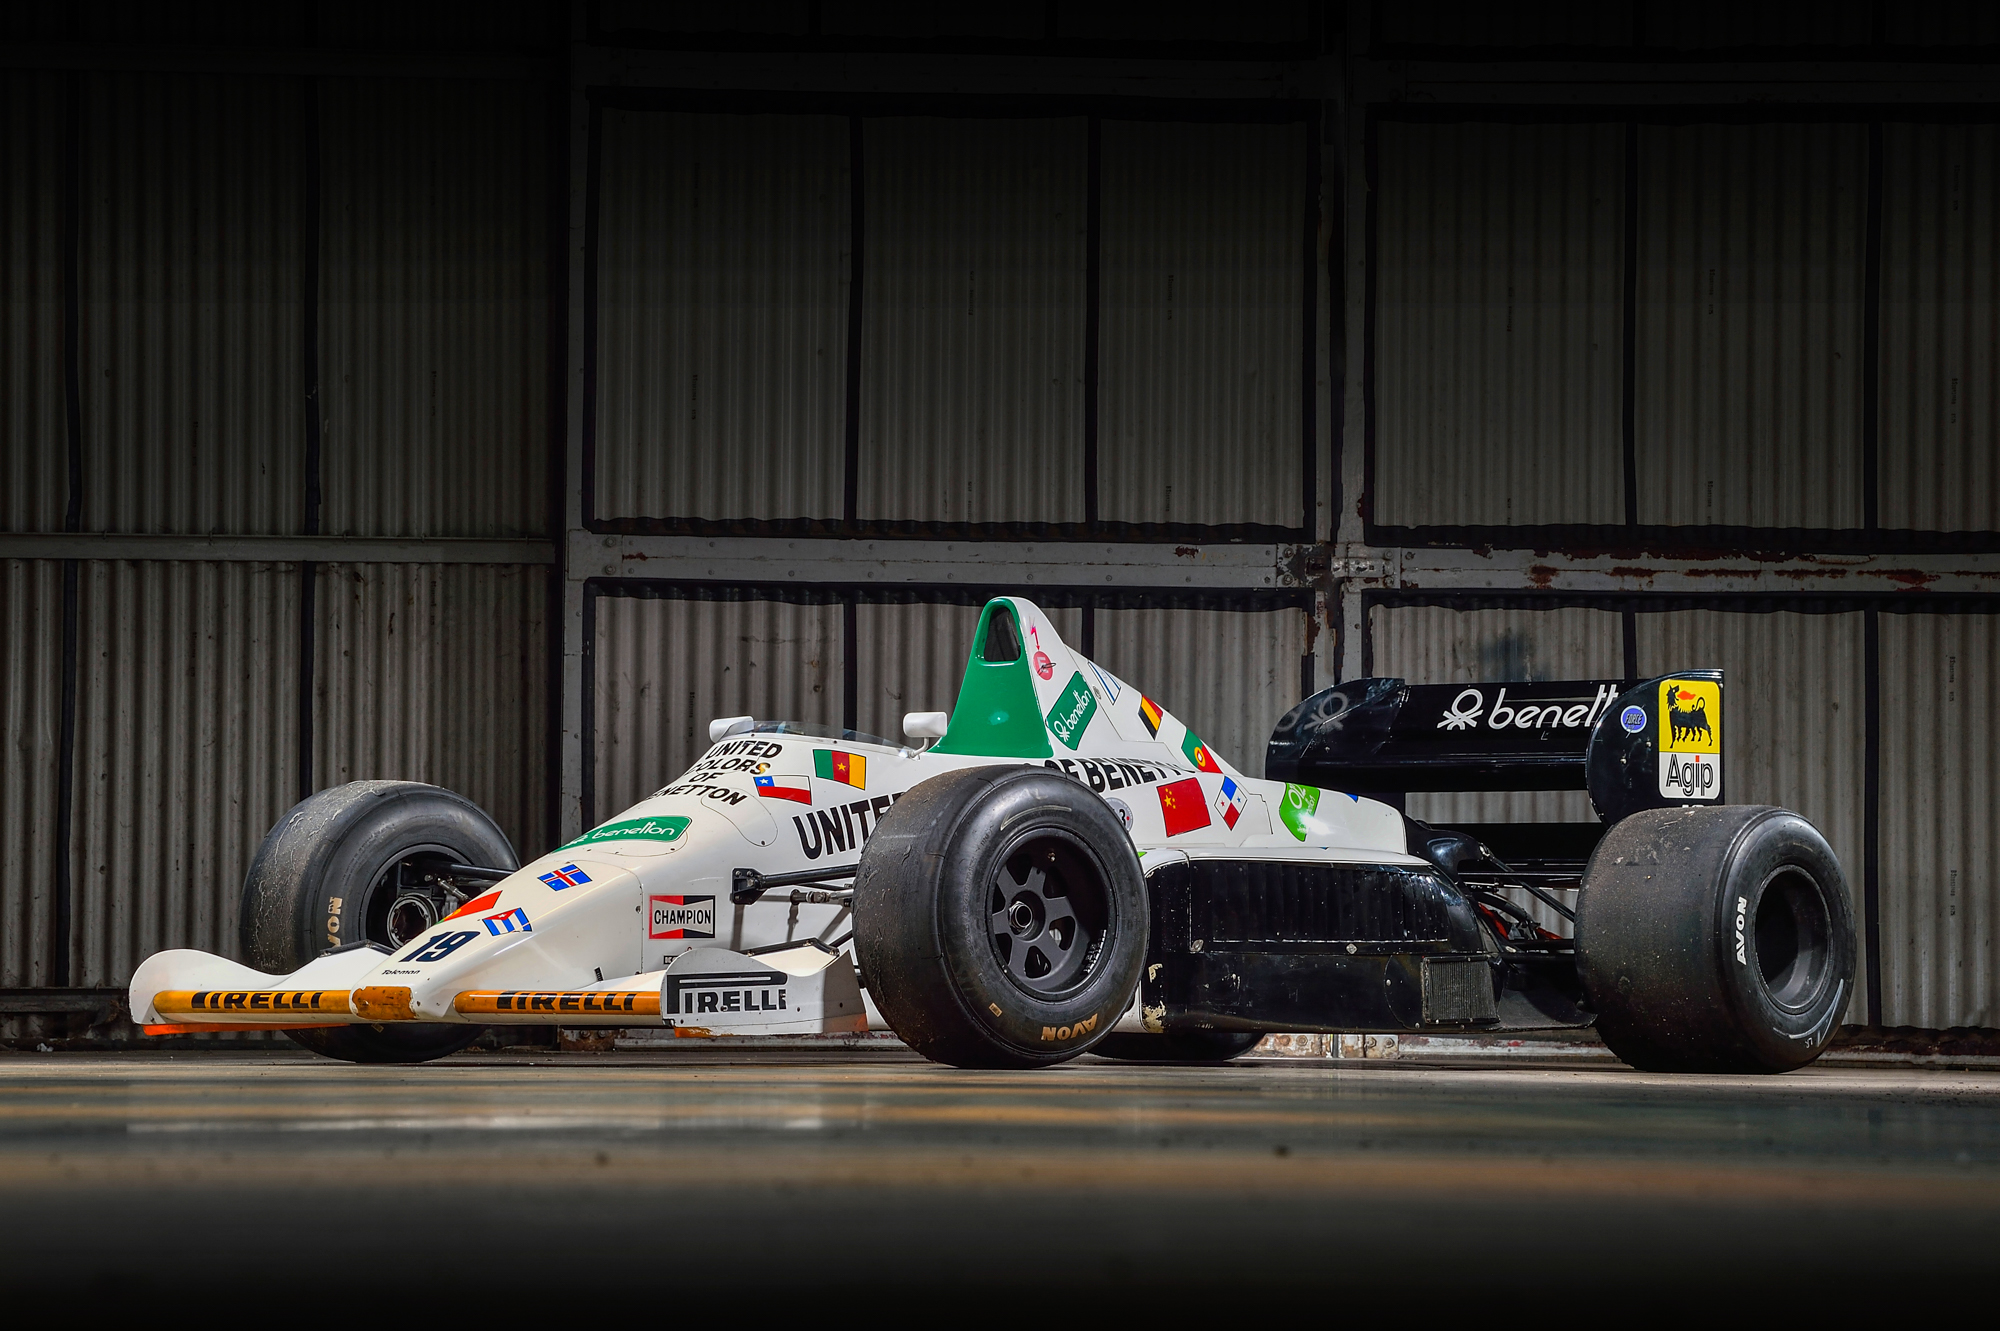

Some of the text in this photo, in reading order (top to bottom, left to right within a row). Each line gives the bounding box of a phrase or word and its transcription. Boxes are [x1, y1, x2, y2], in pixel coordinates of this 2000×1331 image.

[1059, 689, 1092, 731] benetton
[1488, 684, 1619, 729] benett
[705, 740, 783, 759] UNITED
[688, 772, 724, 783] OF
[1074, 757, 1196, 793] BENETT
[1665, 754, 1714, 797] Agip
[591, 821, 675, 839] benetton
[792, 791, 905, 860] UNITE
[654, 909, 711, 925] CHAMPION
[1735, 896, 1748, 965] AVON
[398, 931, 481, 963] 19
[666, 971, 788, 1014] PIRELLI
[1041, 1013, 1098, 1041] AVON
